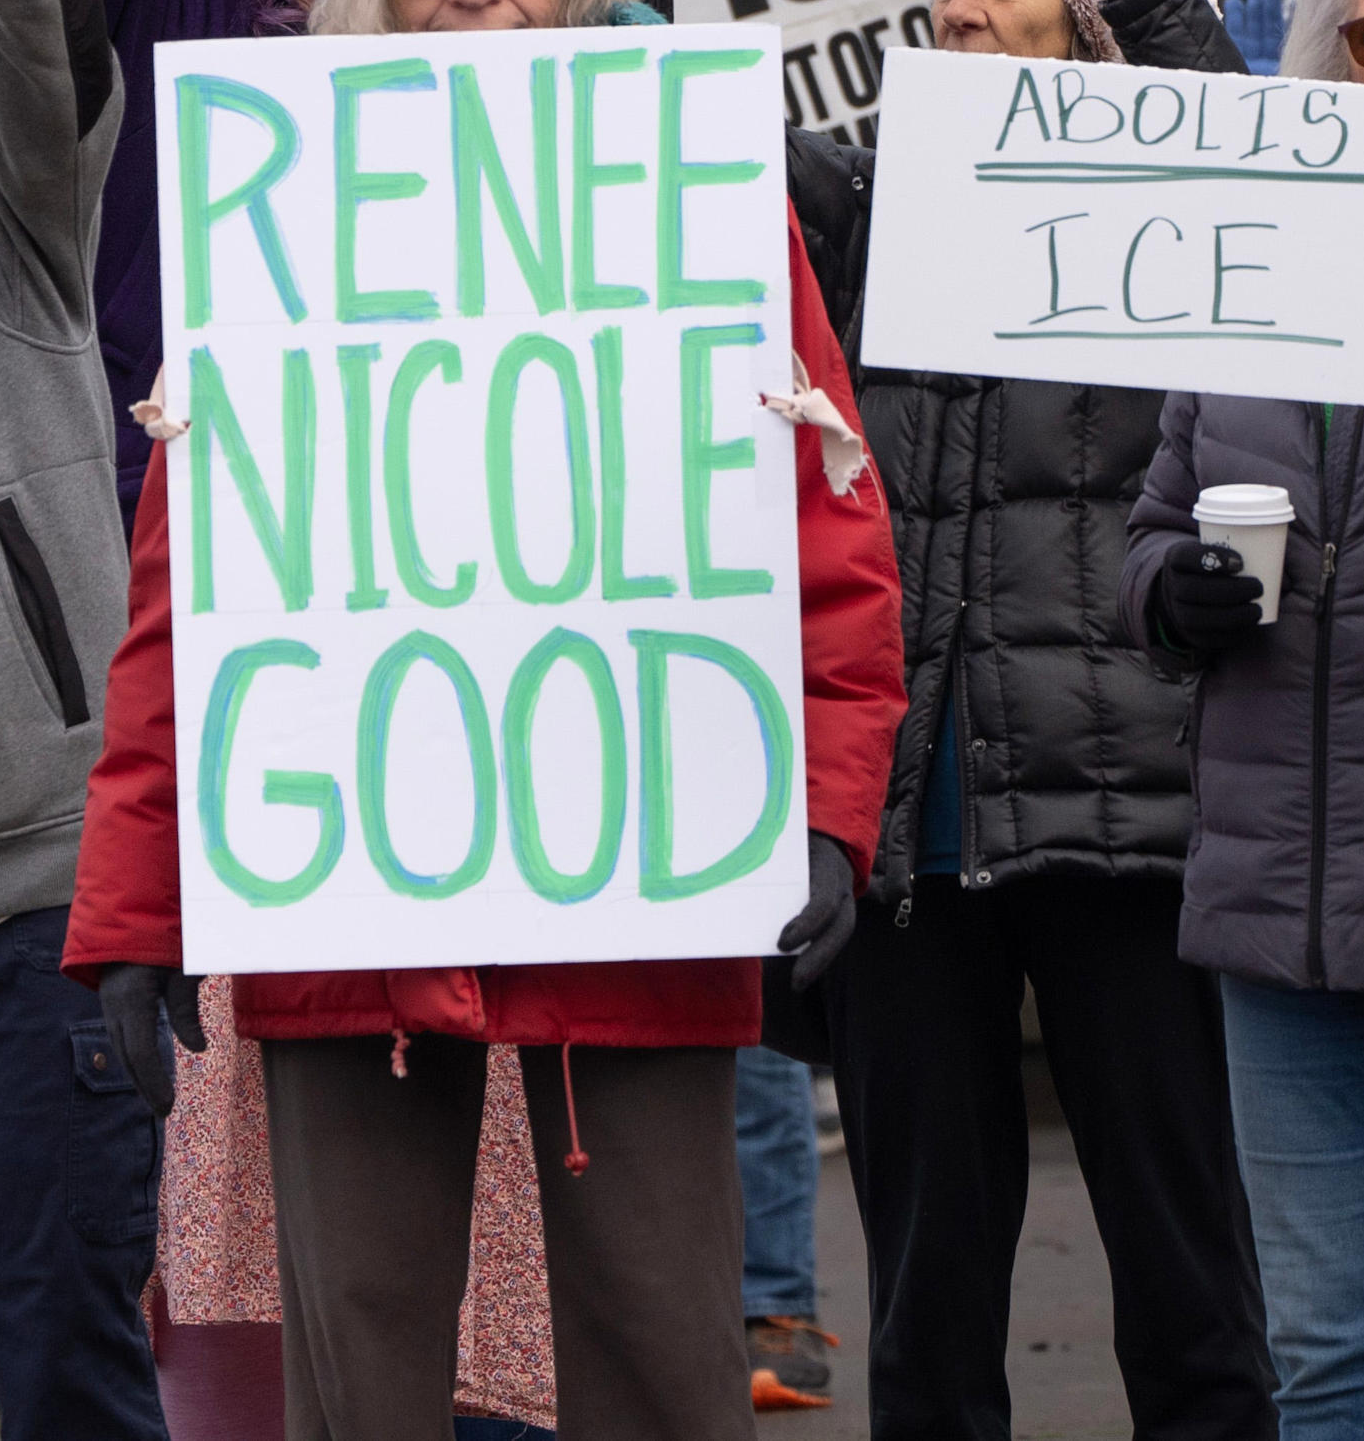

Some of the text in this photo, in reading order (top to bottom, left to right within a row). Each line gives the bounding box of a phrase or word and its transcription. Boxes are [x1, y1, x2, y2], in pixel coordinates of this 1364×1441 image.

[175, 48, 766, 328] RENEE
[1025, 212, 1280, 327] ICE
[187, 323, 776, 615] NICOLE
[197, 625, 795, 908] GOOD
